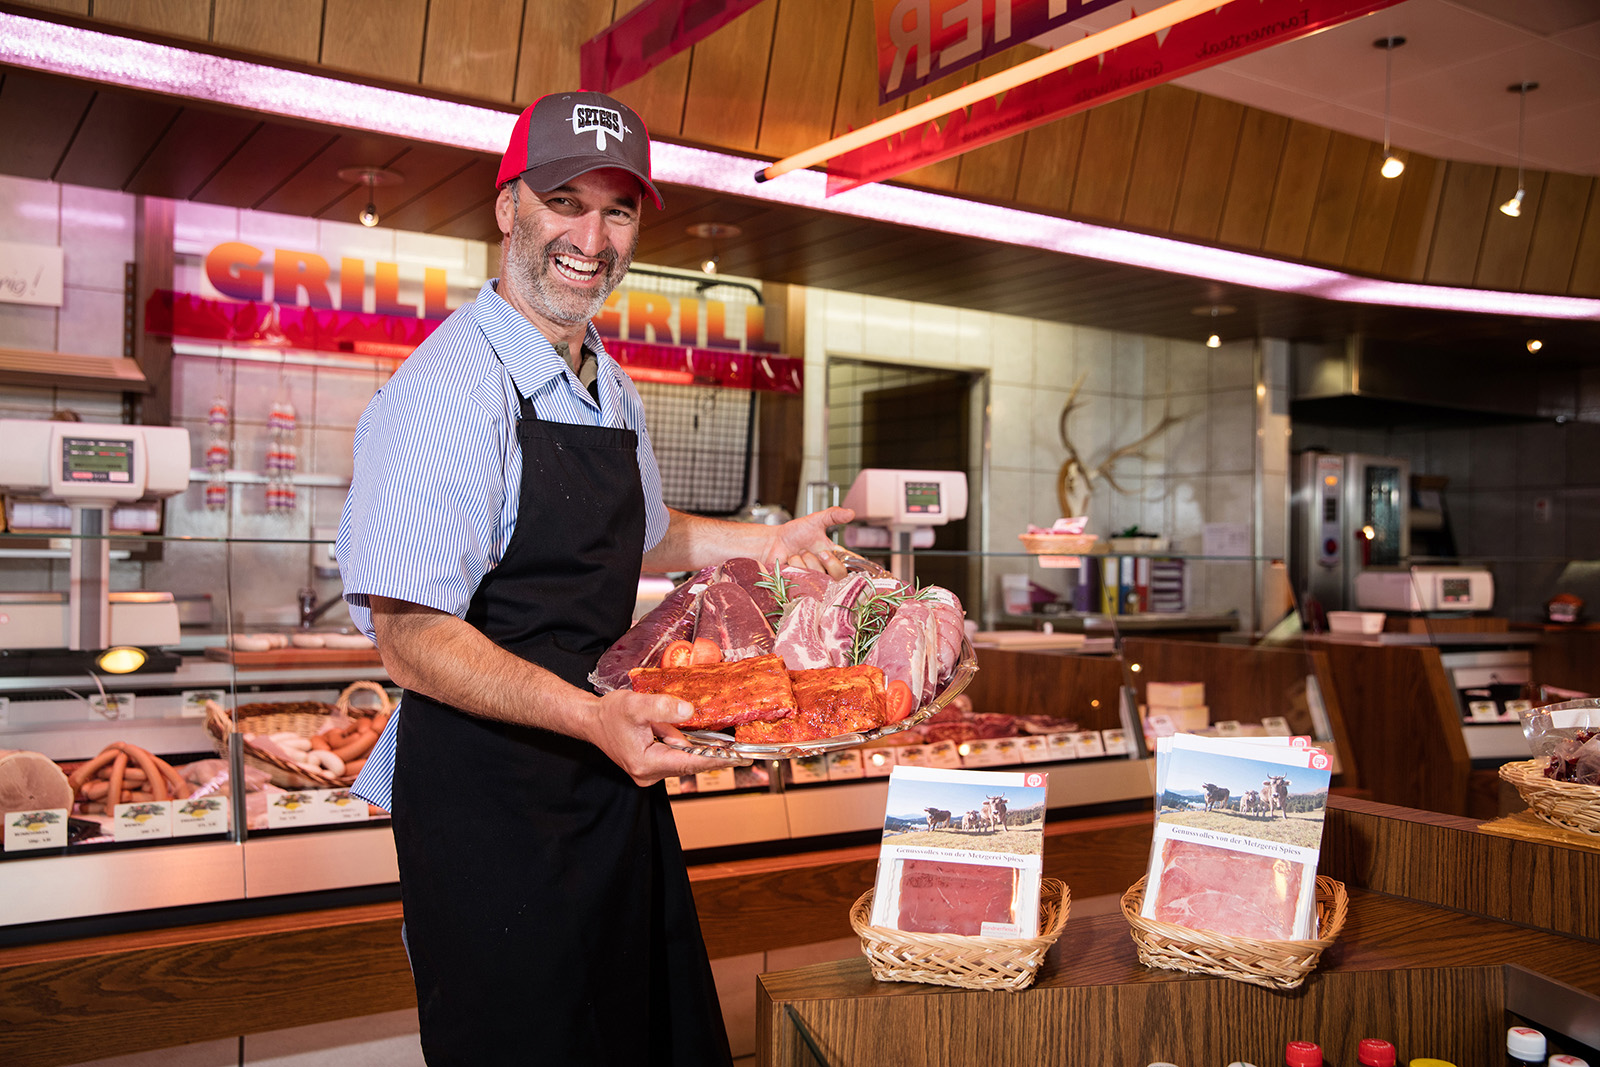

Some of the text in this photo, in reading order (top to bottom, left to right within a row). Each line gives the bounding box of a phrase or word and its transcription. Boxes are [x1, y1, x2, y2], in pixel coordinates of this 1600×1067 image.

[577, 106, 620, 133] SPIESS
[206, 242, 452, 320] GRILL
[1171, 826, 1214, 840] Genussvolles
[1229, 836, 1241, 845] der
[1243, 838, 1278, 851] Metzgerei
[1278, 845, 1301, 855] Spiess
[896, 847, 939, 856] Genussvolles
[968, 852, 1002, 861] Metzgerei
[1003, 854, 1024, 863] Spiess
